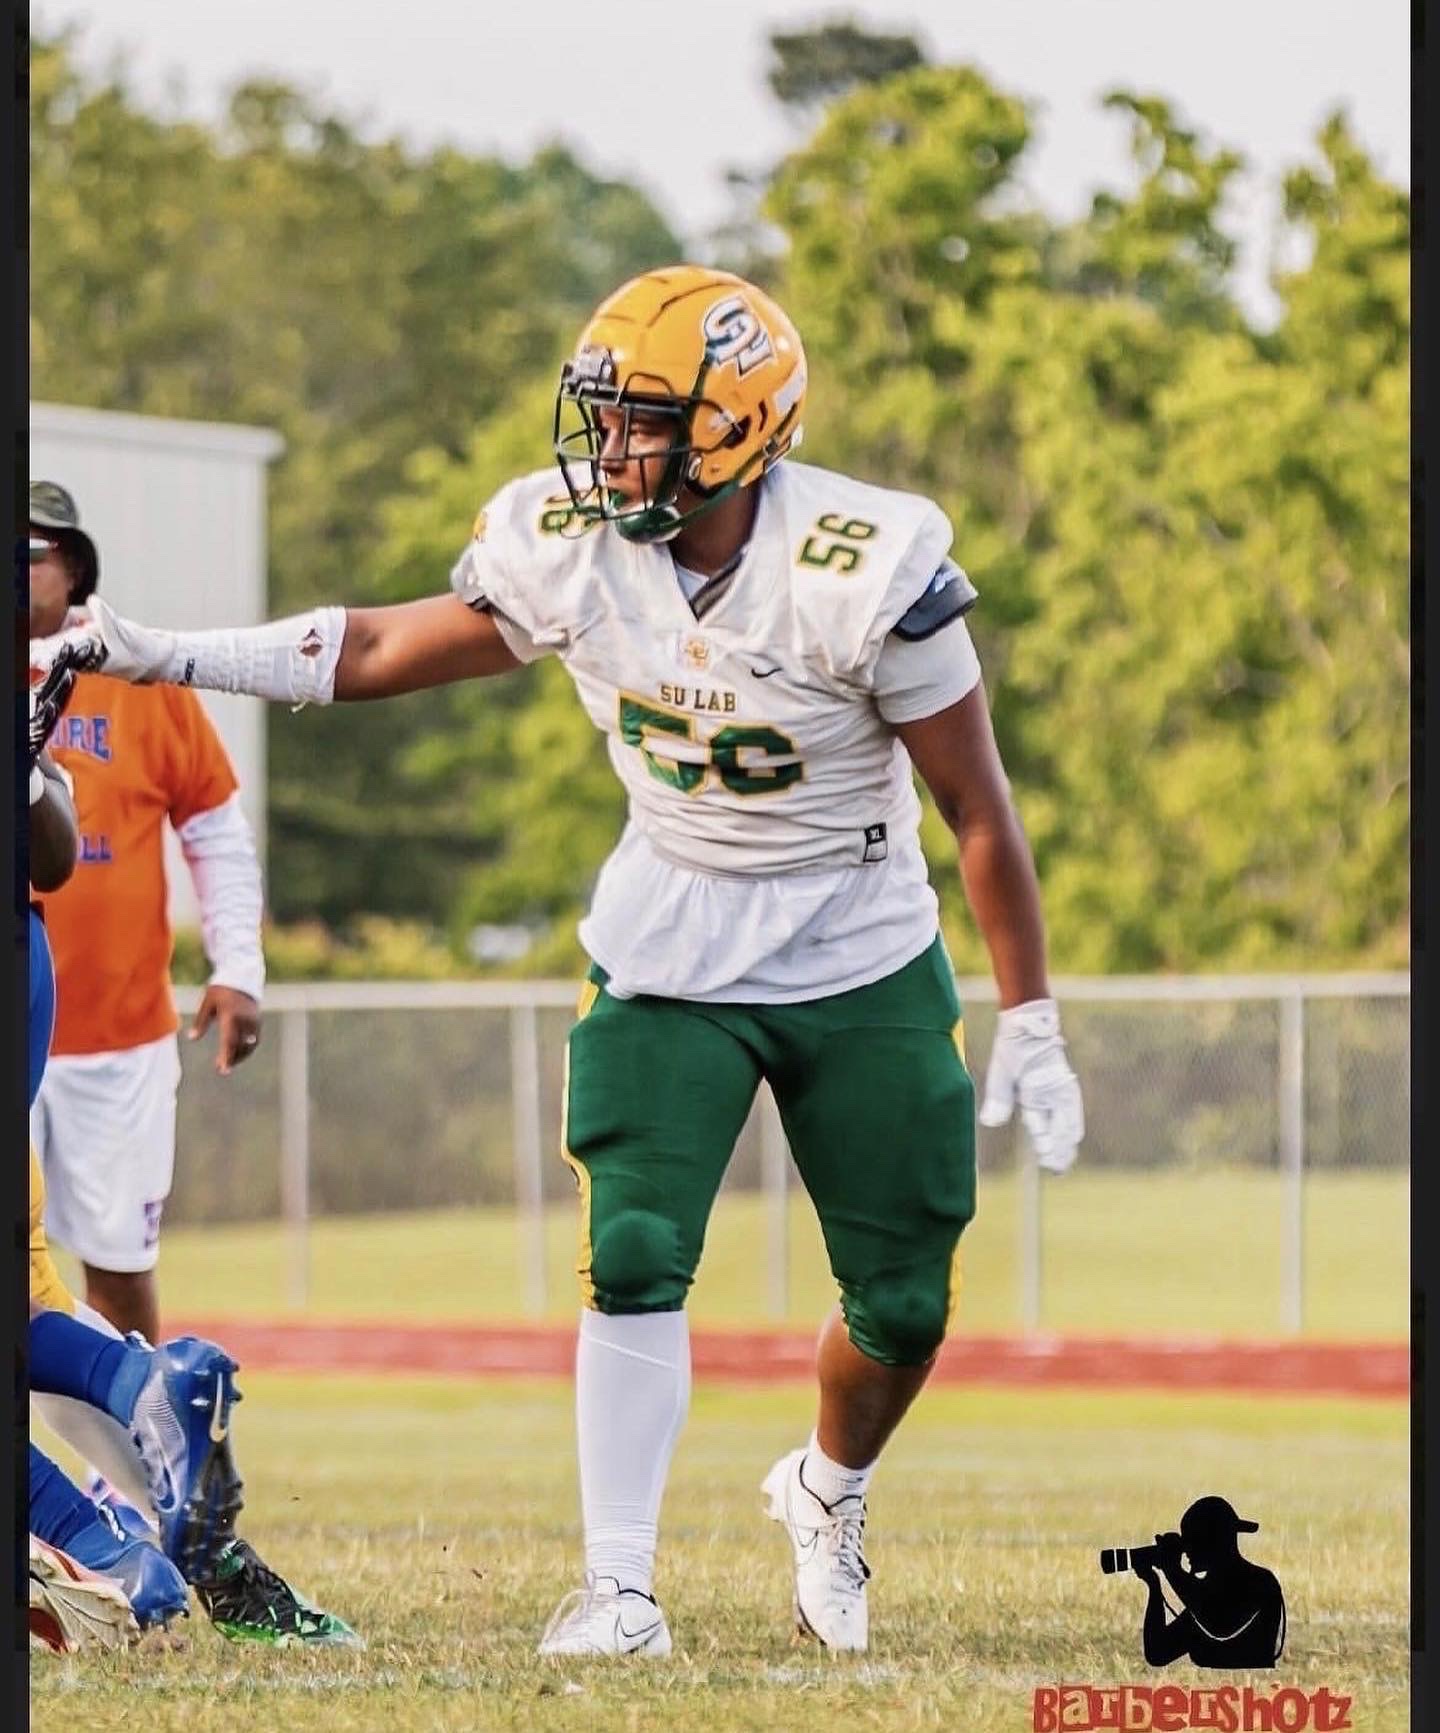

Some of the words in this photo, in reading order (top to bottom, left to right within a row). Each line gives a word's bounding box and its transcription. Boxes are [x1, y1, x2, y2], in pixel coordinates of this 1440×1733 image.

[796, 512, 876, 573] 56
[660, 683, 686, 706] SU
[694, 688, 736, 712] LAB
[617, 687, 806, 799] 56
